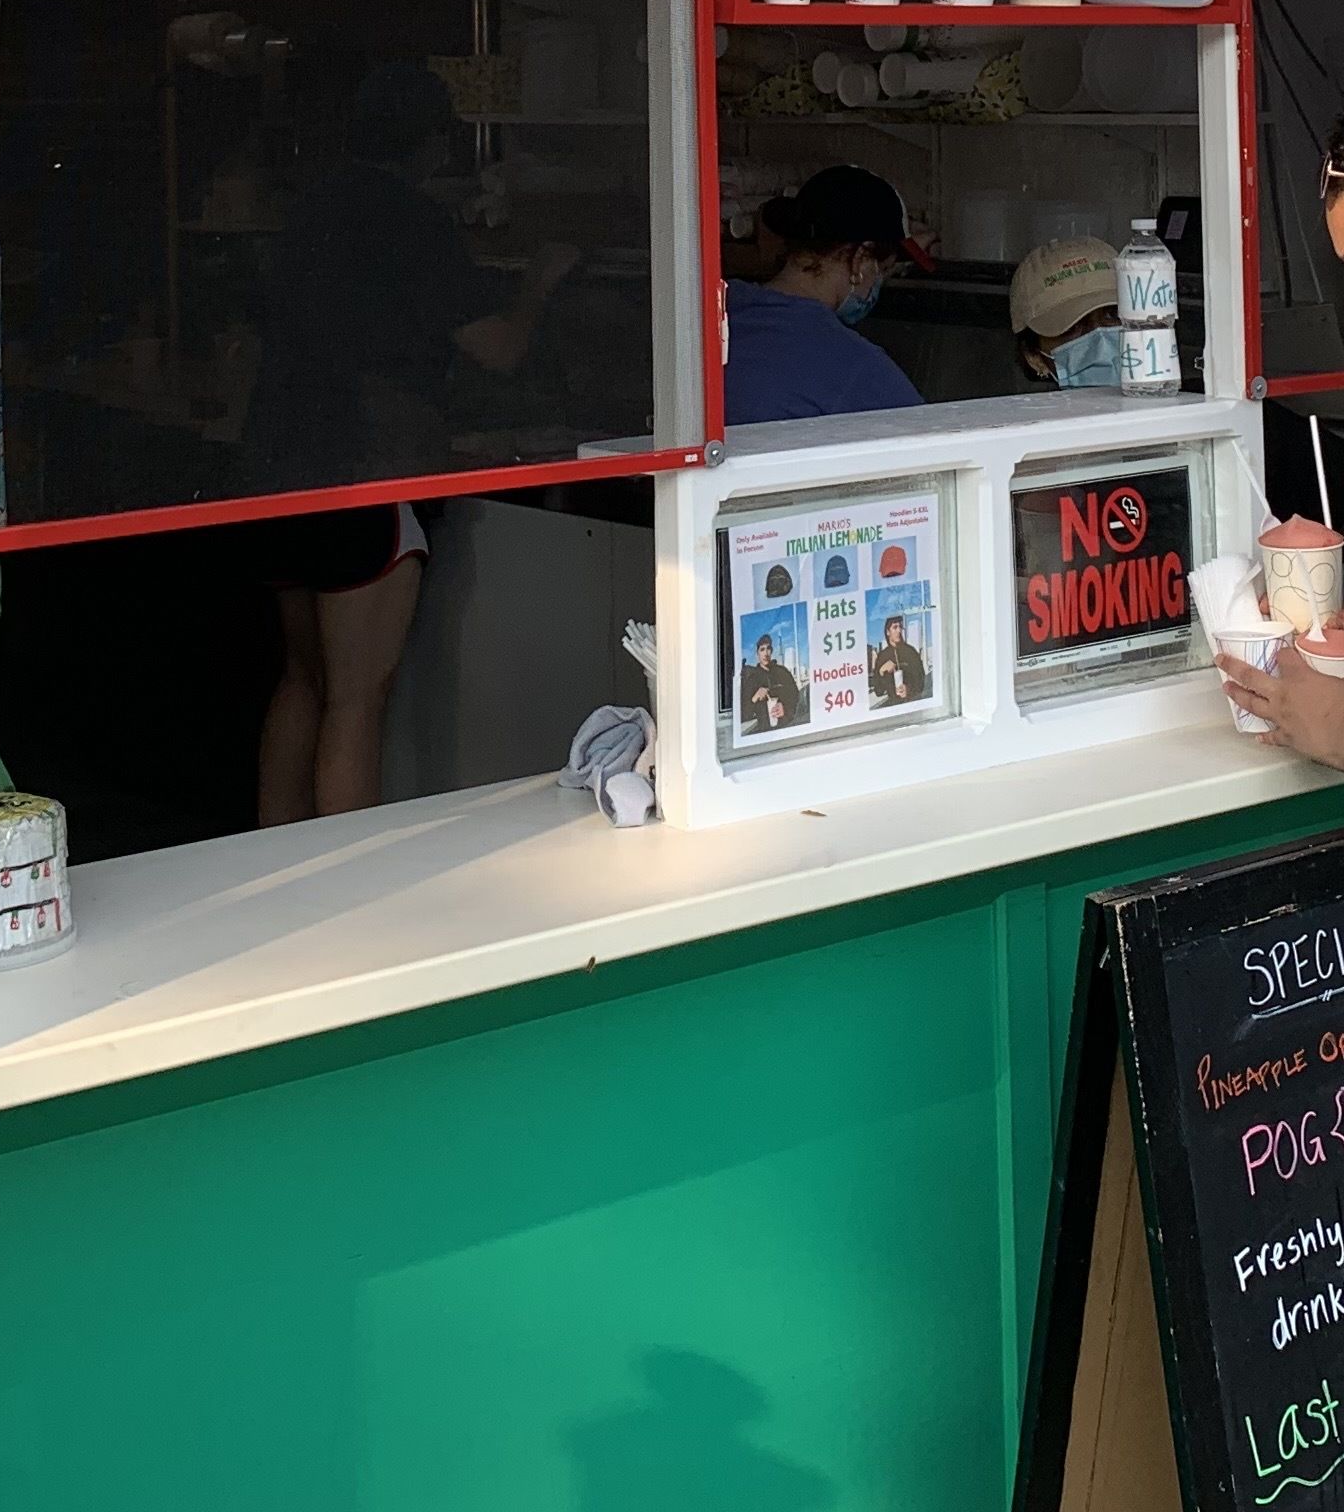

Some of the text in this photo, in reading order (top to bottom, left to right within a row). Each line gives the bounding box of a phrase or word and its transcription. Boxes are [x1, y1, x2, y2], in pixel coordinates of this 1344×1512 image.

[786, 525, 883, 557] ITALIAN LEMONADE
[1059, 486, 1148, 562] NO
[816, 597, 857, 623] Hats
[1026, 551, 1185, 643] SMOKING
[823, 629, 856, 655] $15
[812, 661, 864, 684] Hoodies
[824, 690, 855, 713] $40
[1196, 1051, 1306, 1113] PINEAPPLE
[1240, 1110, 1327, 1196] POG
[1244, 1380, 1341, 1480] Last
